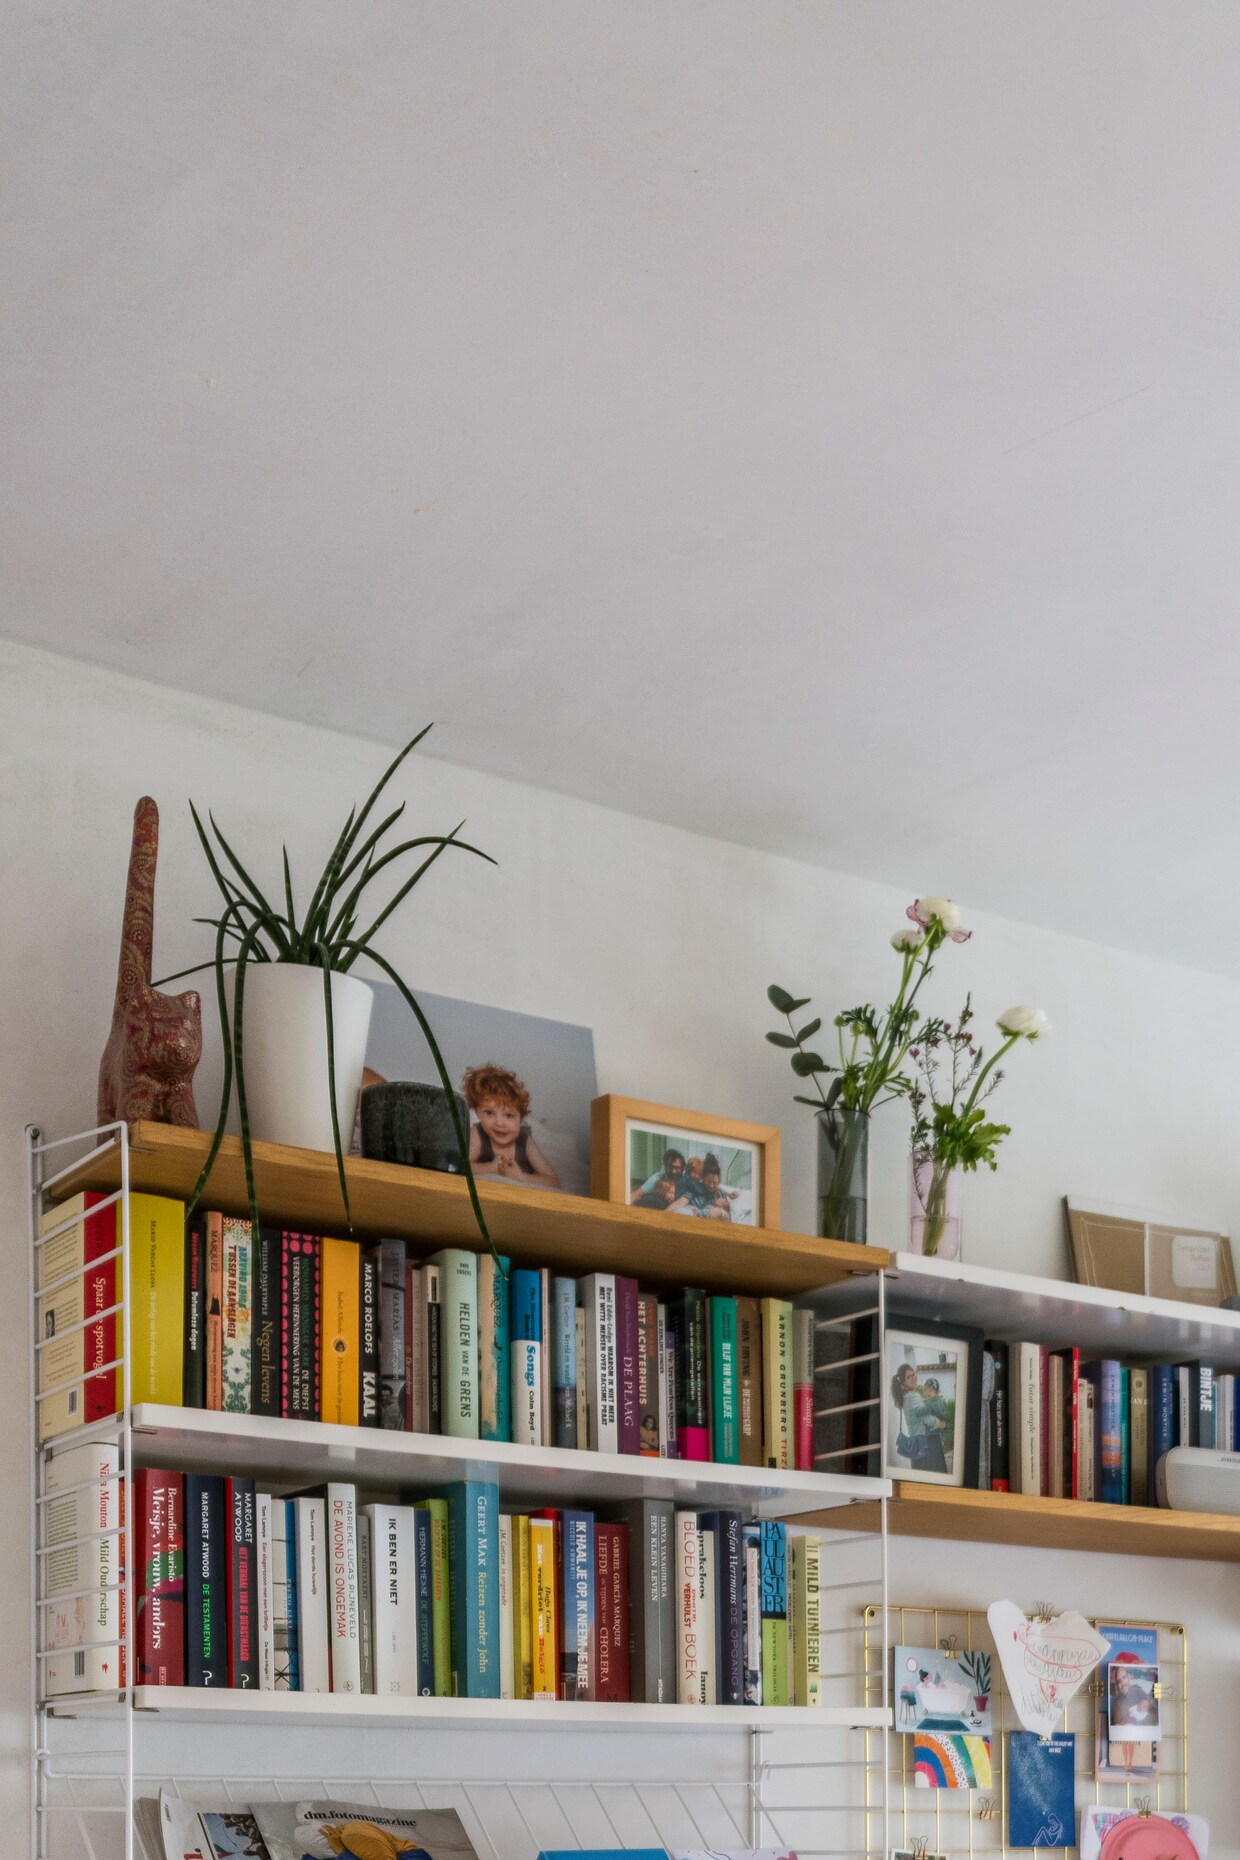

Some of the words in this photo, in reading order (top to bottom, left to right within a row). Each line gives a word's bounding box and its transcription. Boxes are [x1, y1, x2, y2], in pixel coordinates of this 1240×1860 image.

[227, 1246, 236, 1277] TUSSEN
[93, 1277, 106, 1307] Spaar
[227, 1280, 236, 1290] DE
[364, 1264, 372, 1303] MARCO
[191, 1292, 199, 1327] Datumloze
[227, 1291, 236, 1338] AANSLAGEN
[459, 1302, 470, 1346] HELDEN
[190, 1329, 198, 1350] dagen
[257, 1321, 273, 1361] Negen
[364, 1307, 372, 1353] ROELOFS
[261, 1365, 275, 1403] levens
[292, 1376, 299, 1387] DE
[302, 1370, 309, 1380] DE
[462, 1366, 469, 1376] DE
[525, 1345, 536, 1387] Songs
[623, 1356, 633, 1376] DE
[638, 1329, 646, 1405] ACHTERHUIS
[301, 1384, 309, 1410] DIEPST
[362, 1371, 375, 1417] KAAL
[460, 1380, 471, 1417] GRENS
[624, 1381, 633, 1427] PLAAG
[1200, 1368, 1211, 1411] BINTJE
[1027, 1406, 1036, 1434] simple
[99, 1490, 110, 1528] Mouton
[149, 1486, 164, 1537] Meisje,
[167, 1488, 177, 1541] Bernardine
[201, 1492, 209, 1539] MARGARET
[234, 1492, 242, 1542] ATWOOD
[244, 1492, 252, 1543] MARGARET
[333, 1501, 343, 1515] DE
[346, 1501, 354, 1544] MARIEKE
[388, 1518, 396, 1530] IK
[478, 1496, 486, 1535] GEERT
[576, 1521, 586, 1532] IK
[100, 1539, 109, 1563] Mild
[334, 1520, 344, 1559] AVOND
[478, 1537, 487, 1566] MAK
[576, 1534, 586, 1564] HAAL
[684, 1521, 695, 1577] BLOED
[727, 1520, 737, 1552] Stefan
[150, 1542, 161, 1592] vrouw,
[167, 1544, 177, 1582] Evaristo
[201, 1542, 210, 1578] ATWOOD
[335, 1563, 344, 1574] IS
[389, 1561, 397, 1575] ER
[576, 1565, 586, 1579] JE
[599, 1536, 607, 1575] LIEFDE
[202, 1584, 210, 1596] DE
[478, 1571, 487, 1606] Reizen
[575, 1581, 587, 1598] OP,
[613, 1573, 621, 1604] GARCÍA
[729, 1556, 737, 1604] Hertmans
[807, 1558, 818, 1593] MILD
[97, 1566, 110, 1626] Oudrschap
[335, 1580, 345, 1638] ONGEMAK
[348, 1585, 356, 1639] RIJNEVELD
[577, 1601, 587, 1612] IK
[203, 1598, 211, 1658] TESTAMENTEN
[479, 1610, 488, 1645] zonder
[577, 1614, 587, 1647] NEEM
[613, 1606, 622, 1647] MÁRQUEZ
[731, 1608, 738, 1625] DE
[808, 1599, 819, 1672] TUINIEREN
[477, 1648, 487, 1673] John
[577, 1648, 587, 1661] JE
[600, 1628, 608, 1683] CHOLERA
[686, 1634, 696, 1679] BOEK
[731, 1629, 739, 1686] OPGANG
[578, 1663, 588, 1688] MEE
